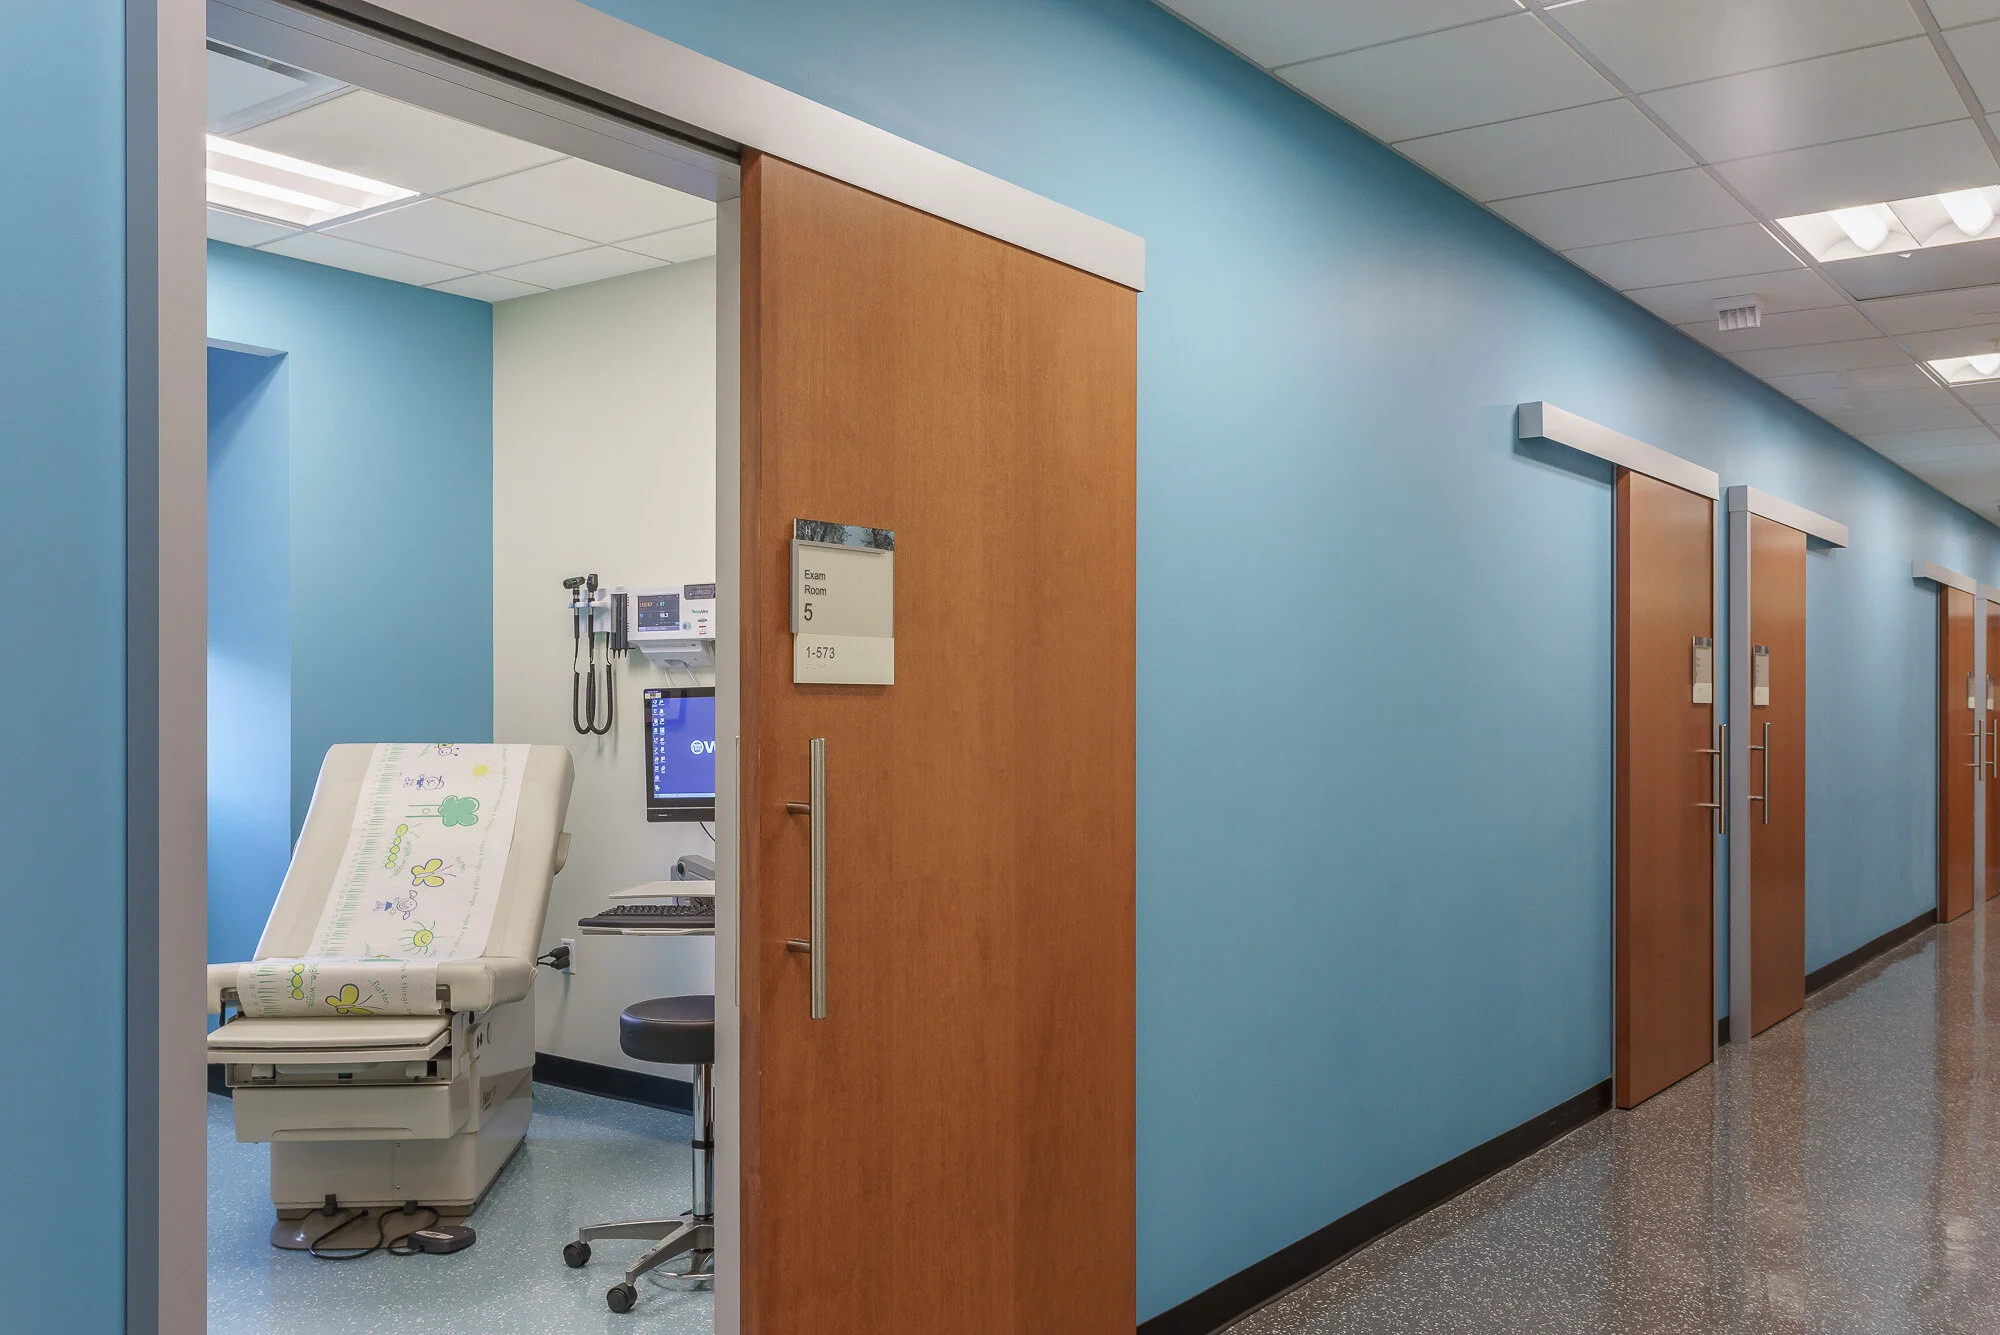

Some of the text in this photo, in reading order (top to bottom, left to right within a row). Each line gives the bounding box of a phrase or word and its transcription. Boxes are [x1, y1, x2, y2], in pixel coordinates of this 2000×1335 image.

[804, 569, 826, 581] Exam
[804, 584, 827, 596] Room
[804, 603, 813, 621] 5
[806, 645, 835, 659] 1-573
